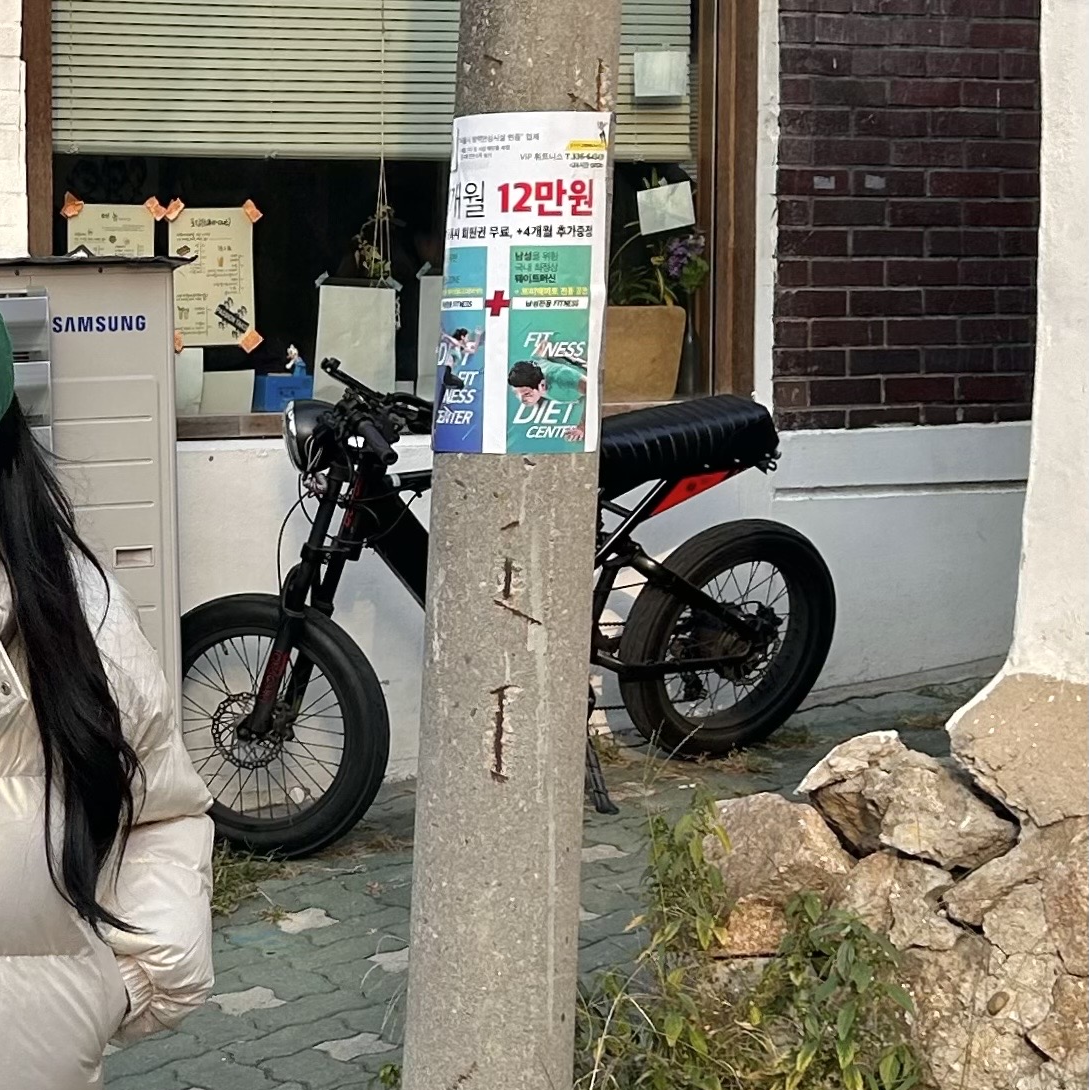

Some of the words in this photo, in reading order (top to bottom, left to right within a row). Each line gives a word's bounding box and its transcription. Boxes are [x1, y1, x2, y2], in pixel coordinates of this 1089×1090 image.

[497, 178, 593, 217] 12만원
[490, 225, 513, 239] 무료,
[517, 225, 553, 239] +4개월
[556, 224, 593, 239] 추가증정
[52, 315, 146, 333] SAMSUNG
[523, 331, 554, 348] FIT
[542, 341, 586, 358] NESS
[442, 388, 477, 405] NESS
[513, 400, 578, 424] DIET
